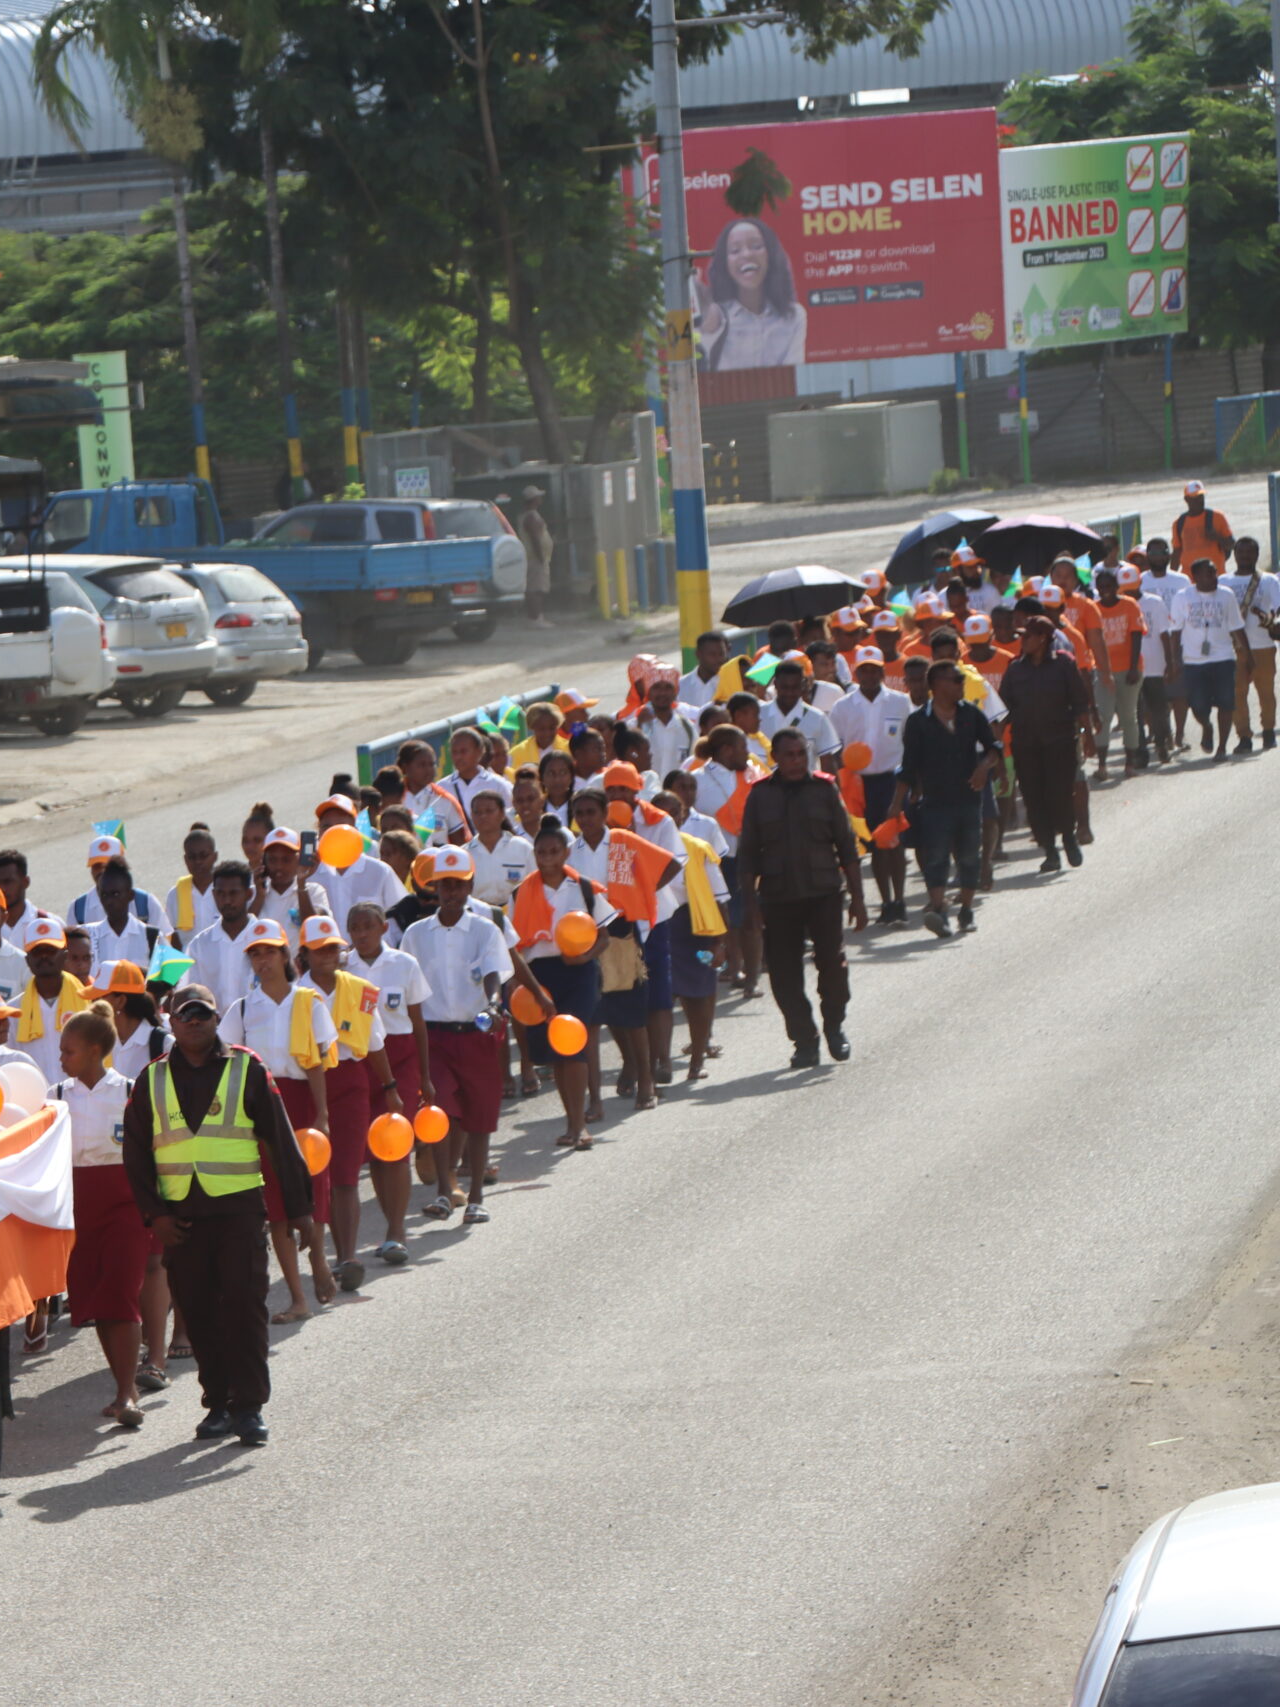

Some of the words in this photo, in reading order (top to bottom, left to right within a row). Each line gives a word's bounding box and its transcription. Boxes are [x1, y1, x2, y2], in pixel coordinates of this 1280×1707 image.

[800, 181, 883, 210] SEND
[890, 173, 983, 203] SELEN
[1007, 185, 1057, 203] SINGLE-USE
[1059, 182, 1093, 198] PLASTIC
[1095, 180, 1120, 194] ITEMS
[803, 206, 902, 236] HOME.
[1009, 199, 1119, 244] BANNED
[804, 251, 828, 264] Dial
[864, 248, 877, 258] or
[880, 241, 935, 258] download
[1026, 252, 1045, 265] From
[804, 265, 825, 278] the
[827, 264, 854, 276] APP
[855, 263, 868, 274] to
